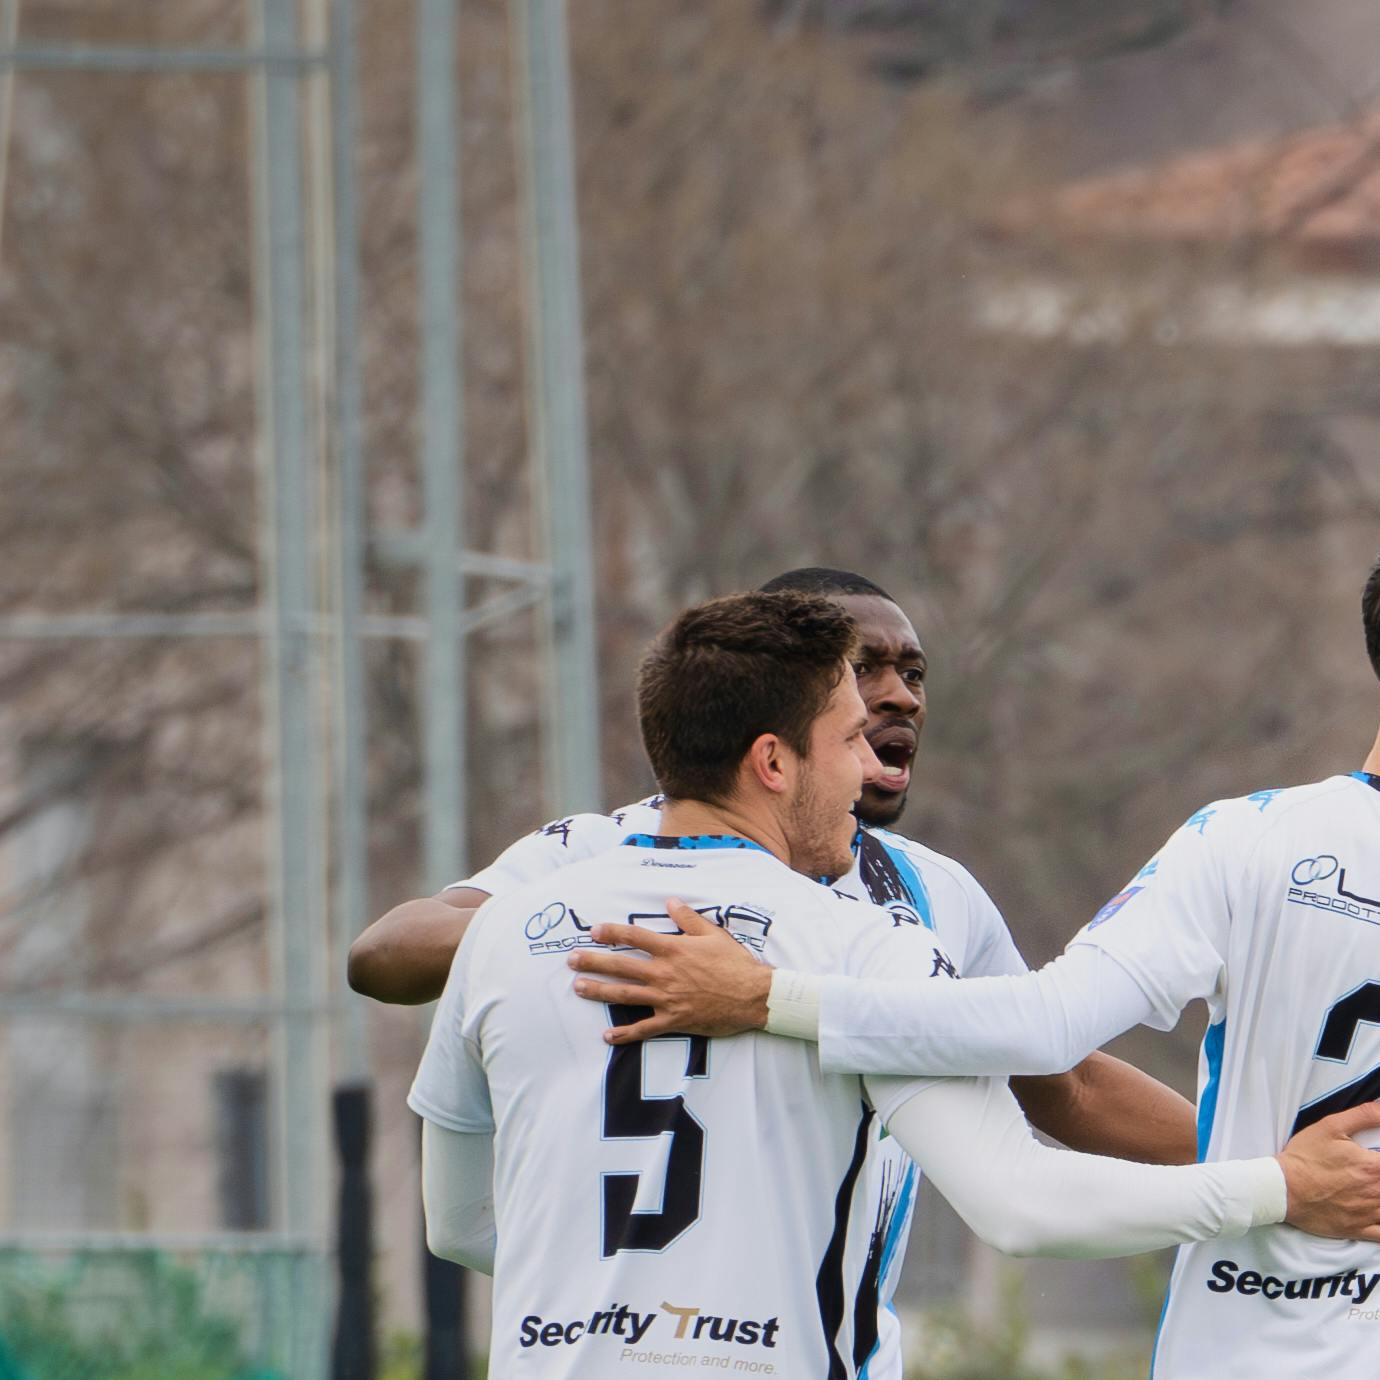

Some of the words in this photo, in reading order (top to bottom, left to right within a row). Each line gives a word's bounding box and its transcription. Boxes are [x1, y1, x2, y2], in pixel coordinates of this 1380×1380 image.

[600, 1002, 712, 1262] 5
[519, 1303, 657, 1348] Secrity
[660, 1301, 779, 1348] Trust
[620, 1348, 696, 1367] Protection
[701, 1356, 729, 1369] and
